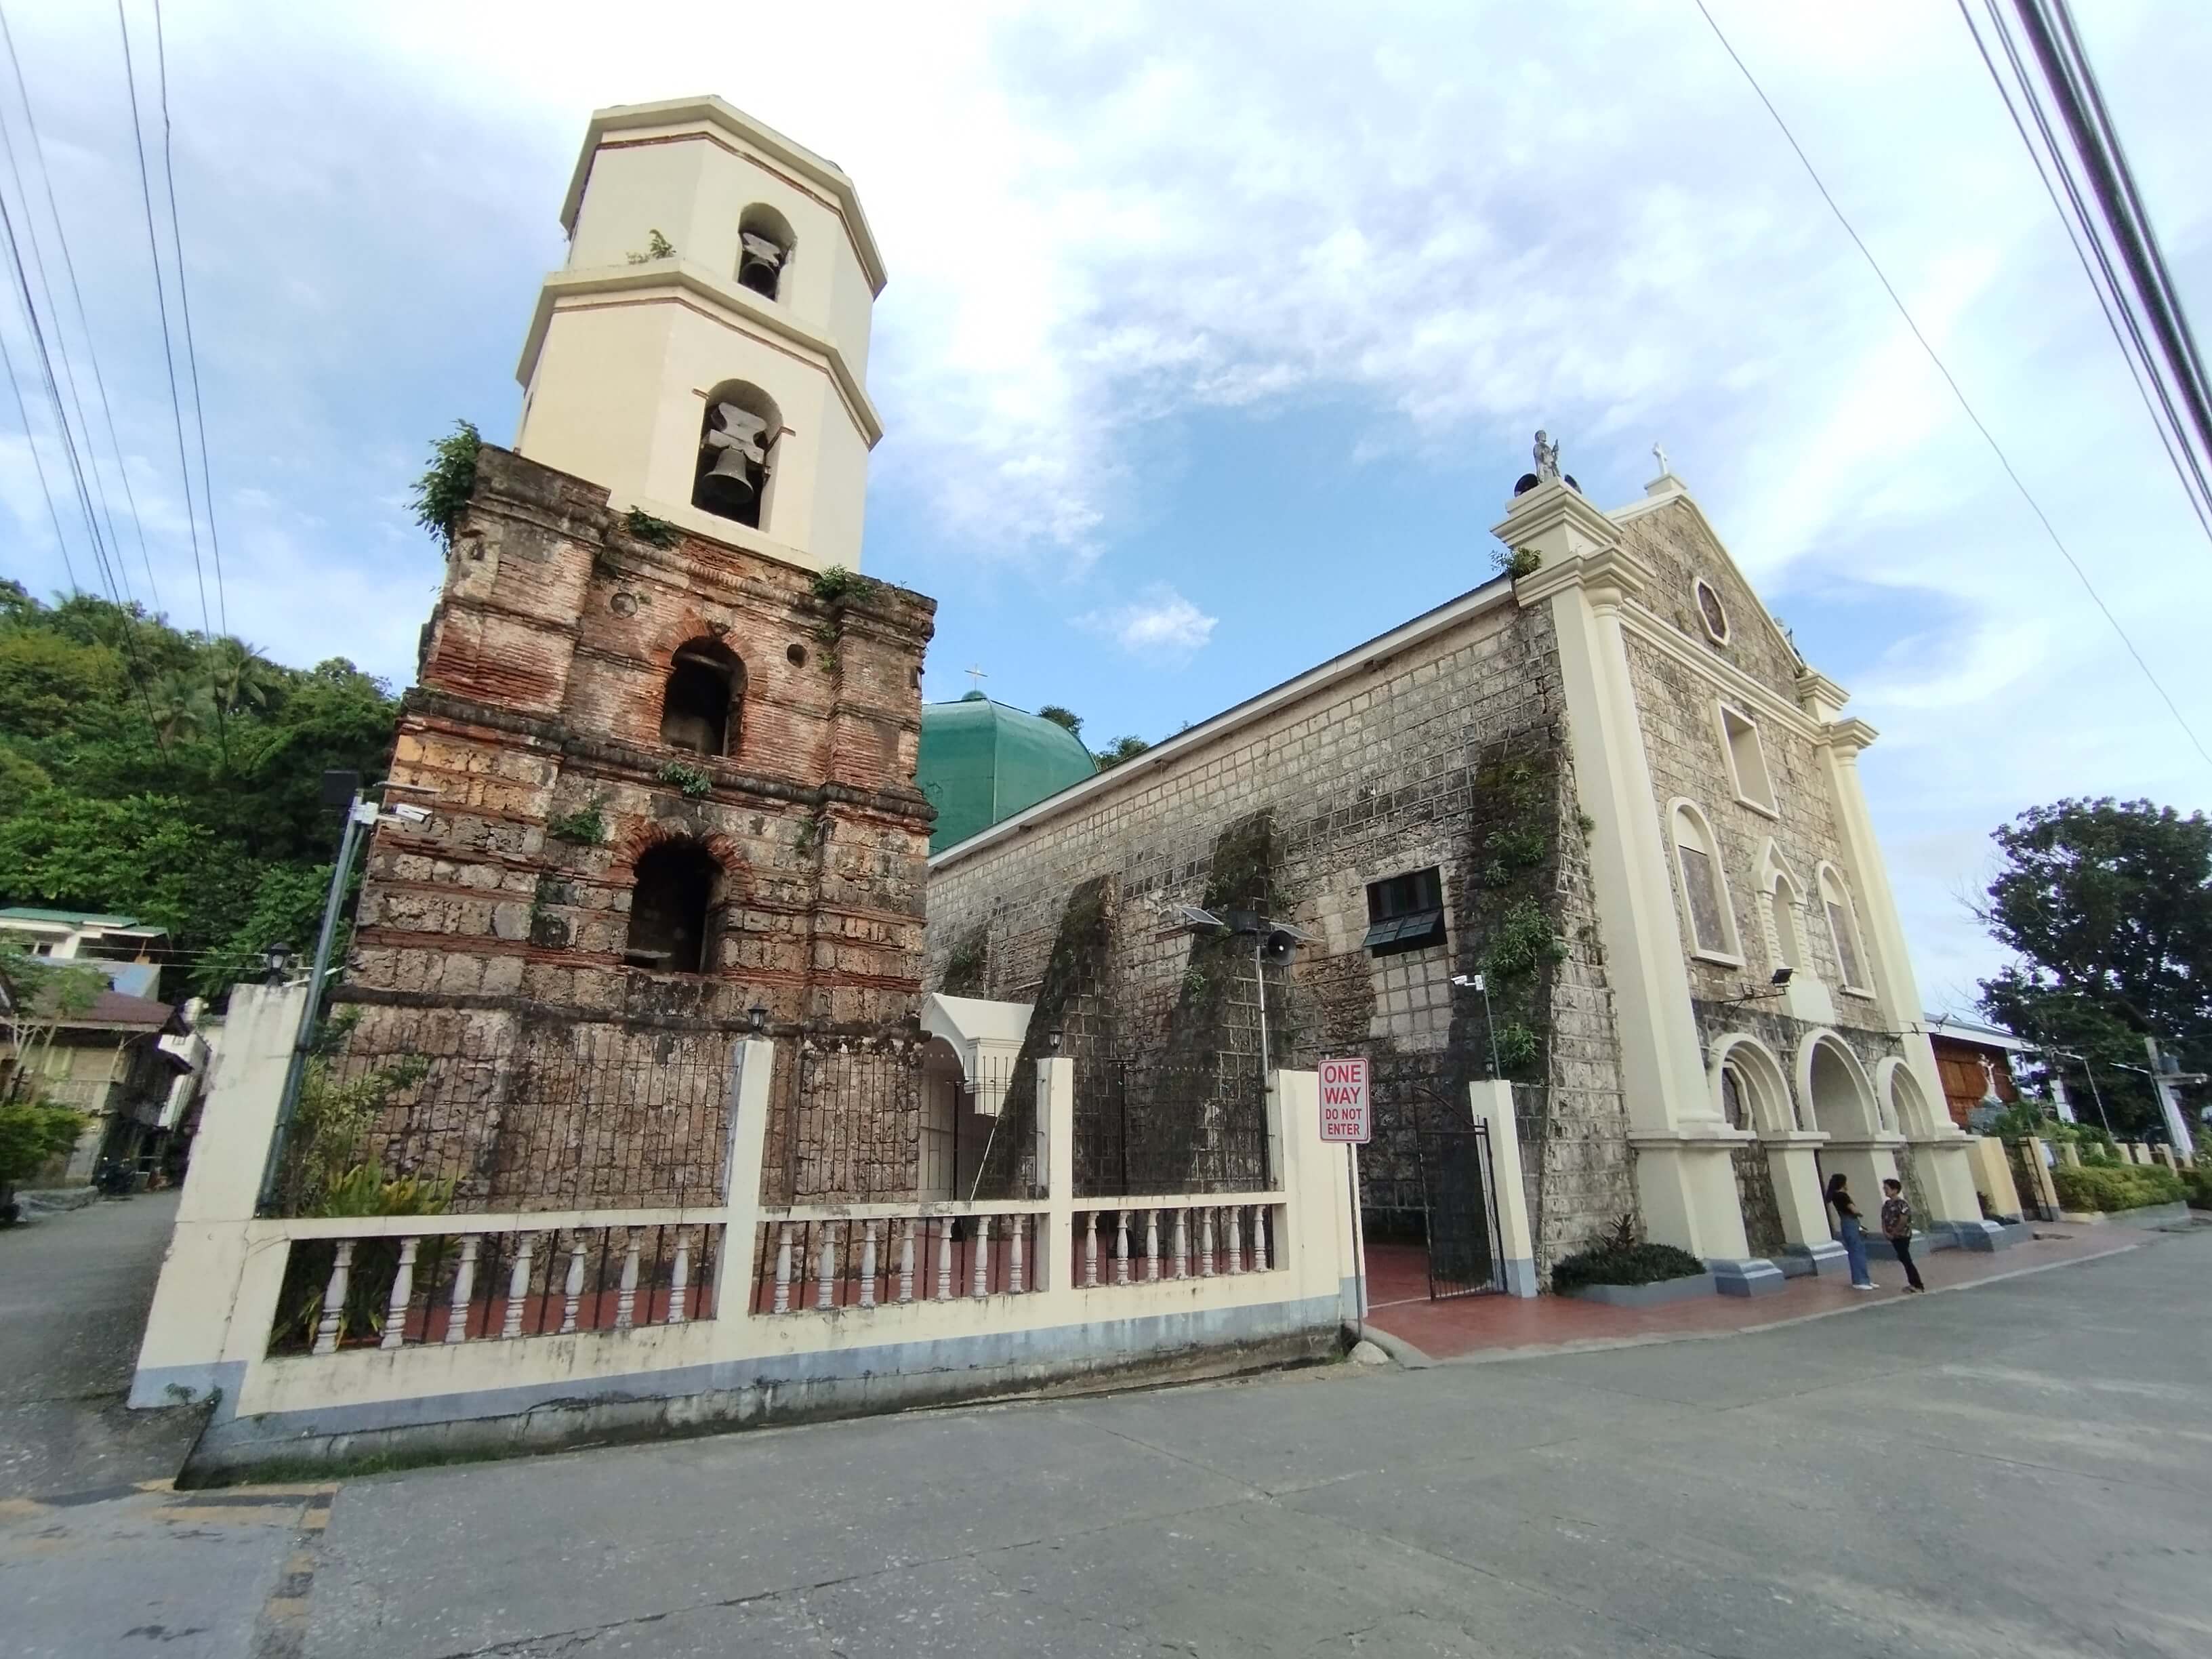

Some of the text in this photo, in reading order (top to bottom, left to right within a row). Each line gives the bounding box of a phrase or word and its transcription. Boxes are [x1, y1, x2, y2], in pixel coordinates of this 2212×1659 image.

[1324, 1065, 1361, 1084] ONE
[1324, 1087, 1361, 1104] WAY
[1326, 1108, 1362, 1120] DO NOT
[1328, 1124, 1360, 1135] ENTER
